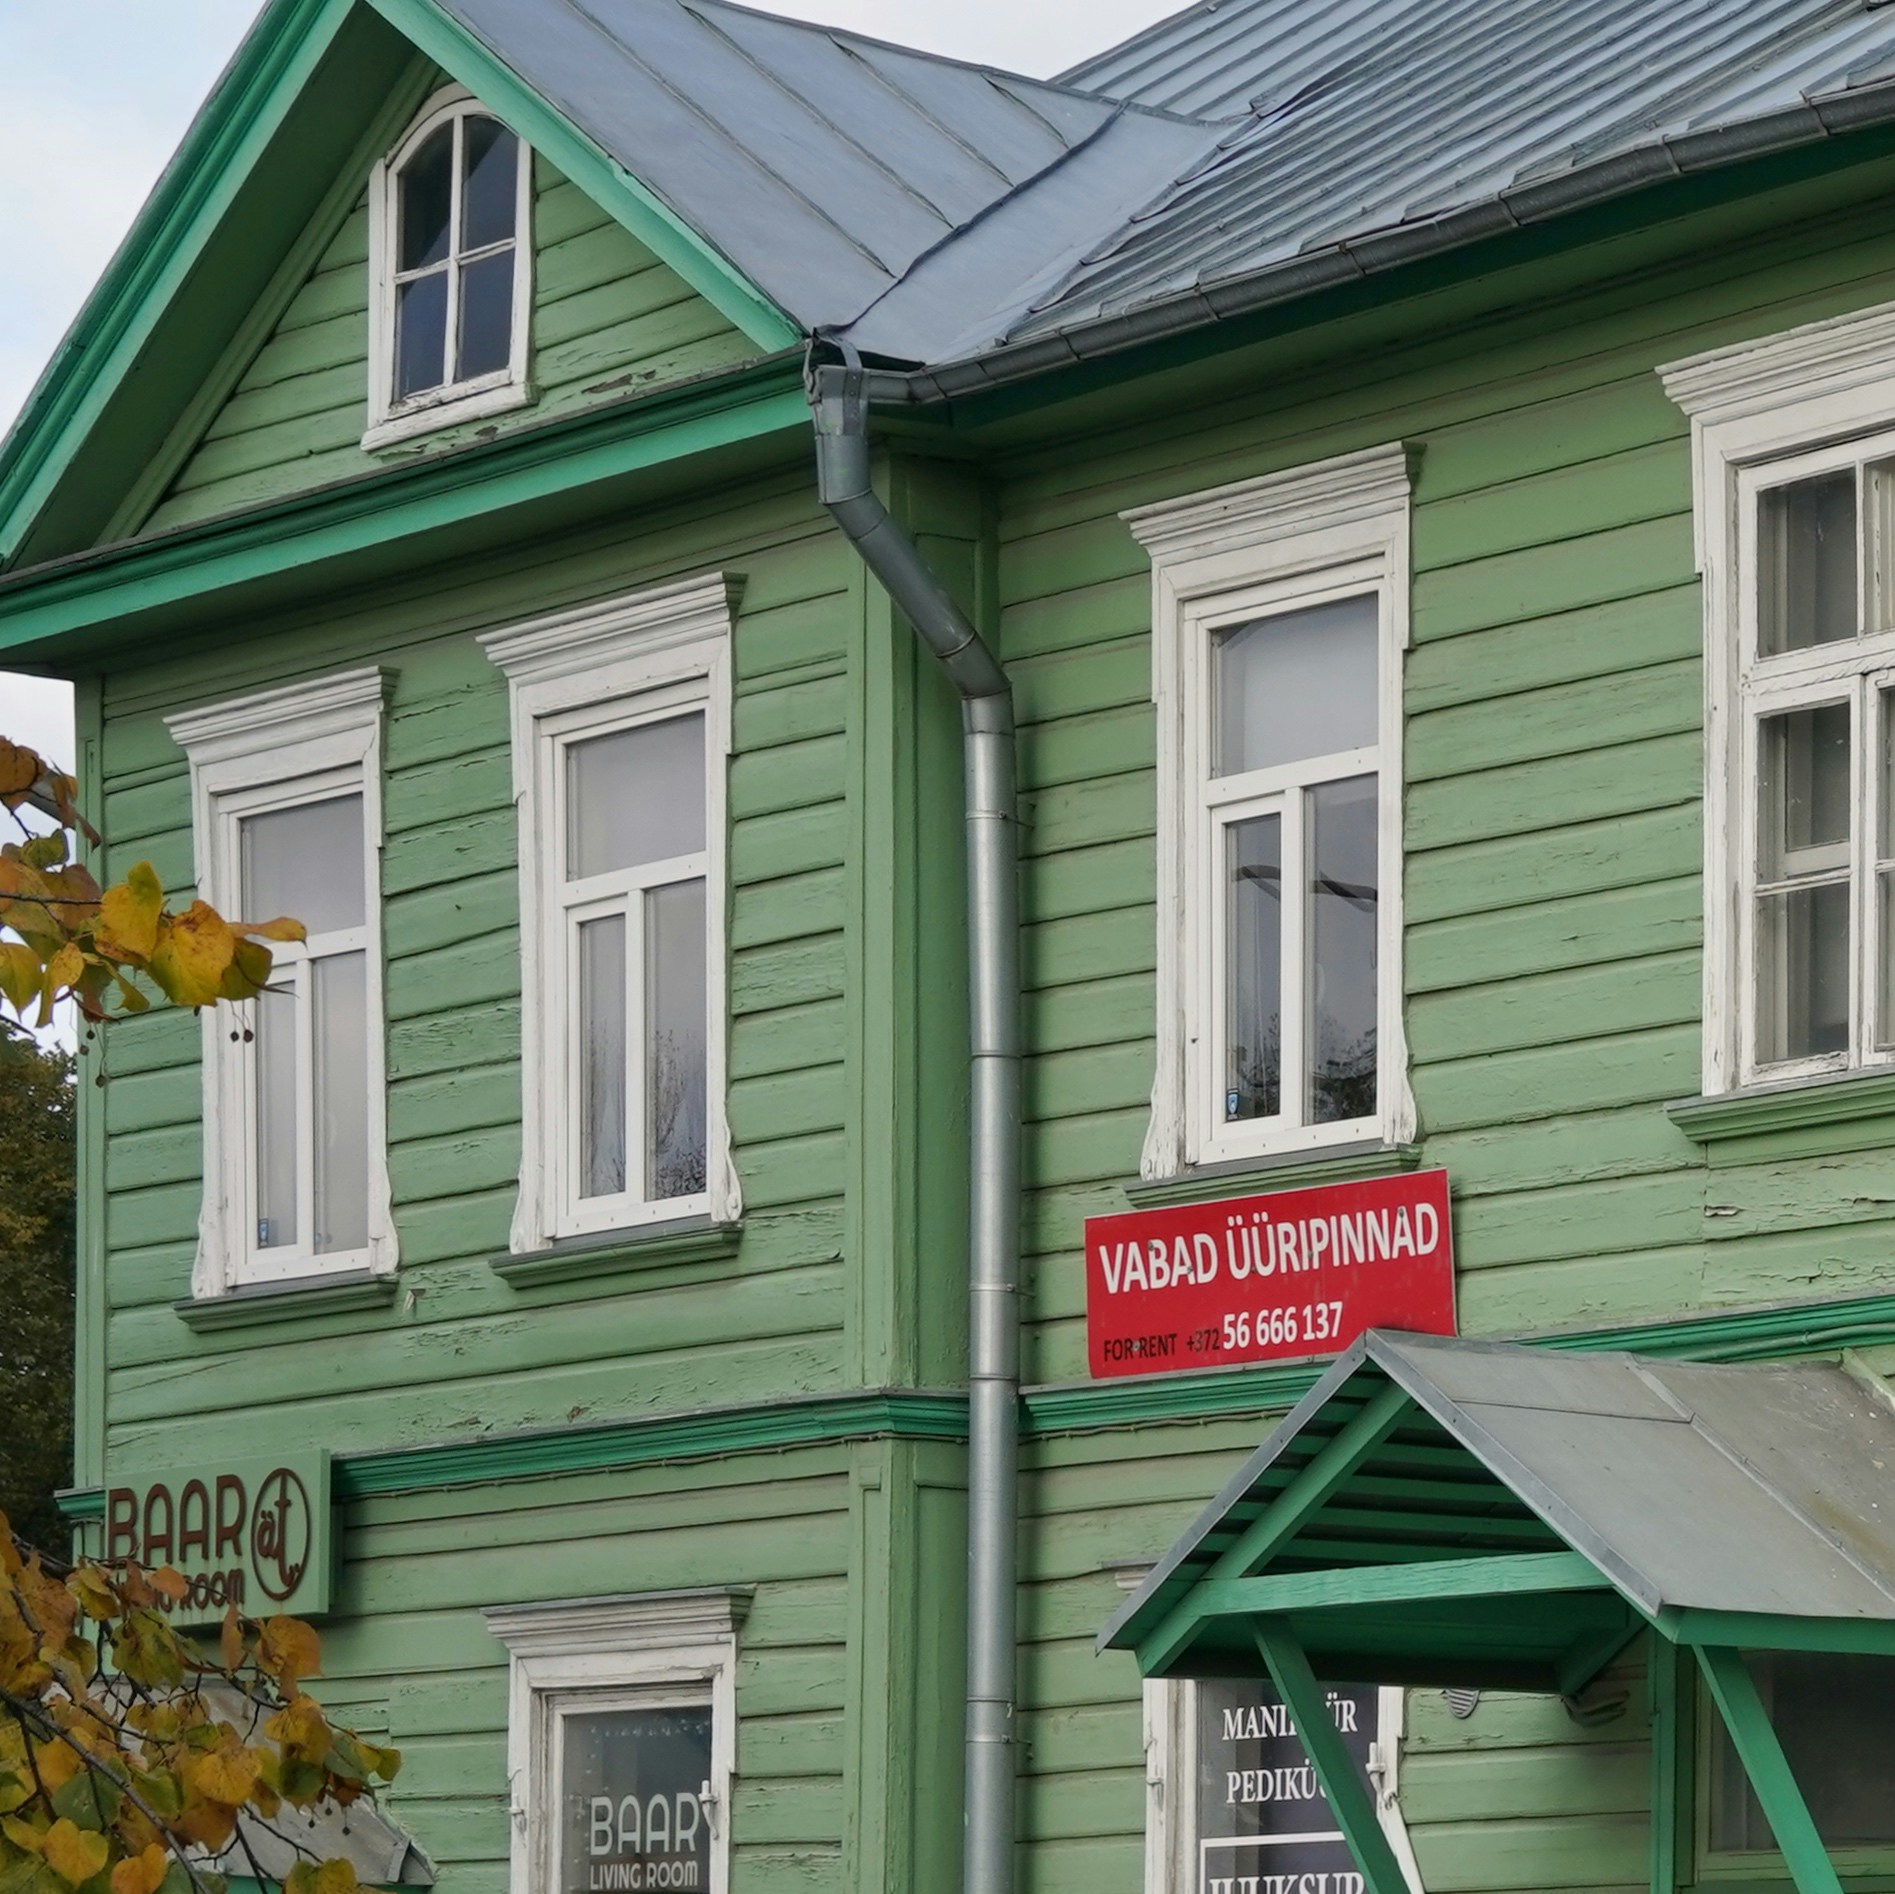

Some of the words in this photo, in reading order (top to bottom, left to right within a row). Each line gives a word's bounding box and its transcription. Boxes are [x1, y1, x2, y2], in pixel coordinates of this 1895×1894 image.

[1099, 1233, 1218, 1294] VABAD
[1226, 1202, 1439, 1280] ÜÜRIPINNAD
[1104, 1339, 1134, 1362] FOR
[1140, 1333, 1177, 1359] RENT
[1186, 1328, 1220, 1352] +372
[1223, 1312, 1250, 1350] 56
[1256, 1306, 1298, 1346] 666
[1302, 1301, 1343, 1341] 137
[108, 1474, 247, 1566] BAAR
[1226, 1758, 1327, 1804] PEDIKÜ
[590, 1792, 700, 1856] BAAR
[590, 1861, 641, 1891] LIVING
[647, 1859, 699, 1888] ROOM
